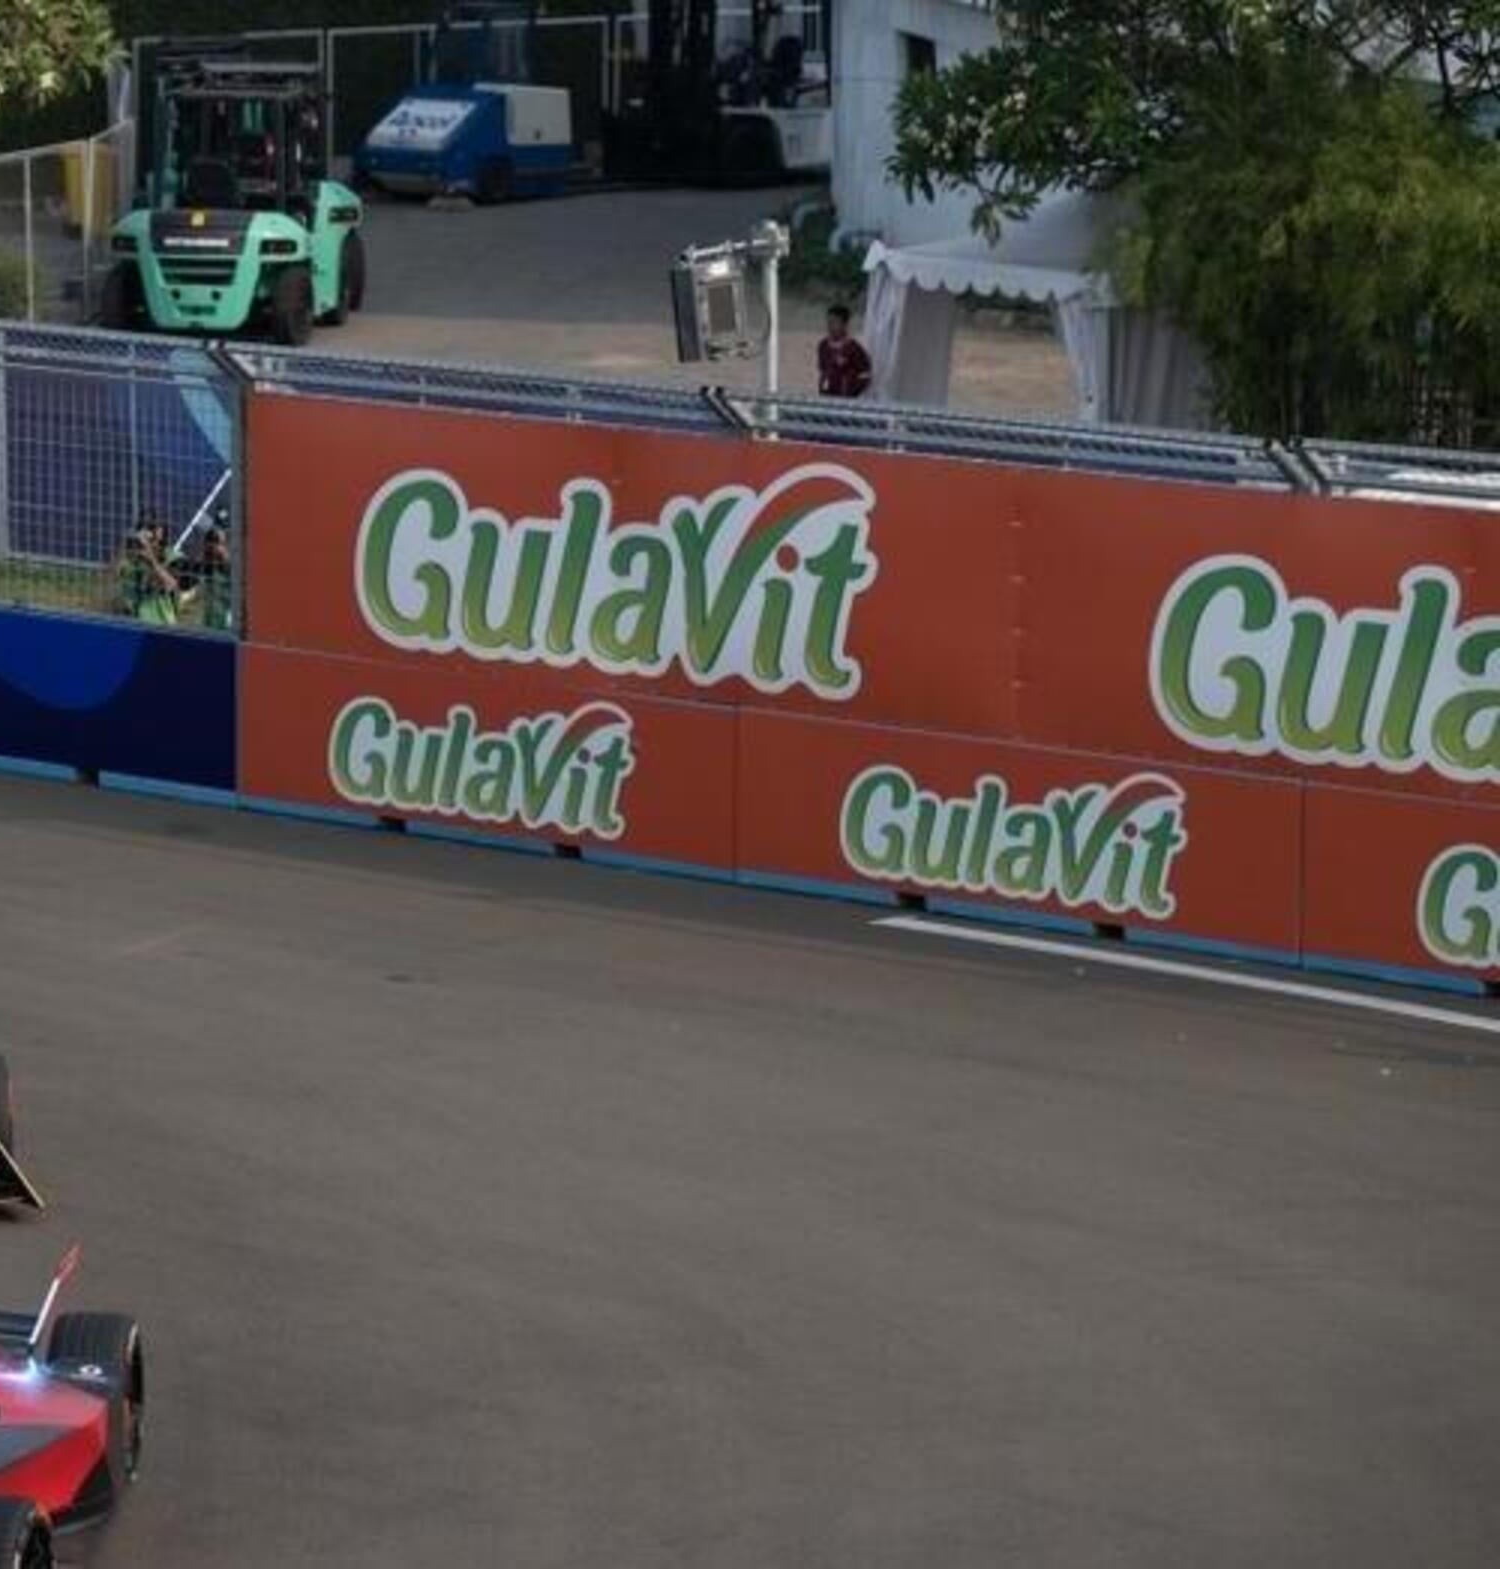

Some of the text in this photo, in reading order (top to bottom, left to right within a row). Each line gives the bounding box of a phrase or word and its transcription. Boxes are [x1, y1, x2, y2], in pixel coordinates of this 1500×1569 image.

[358, 468, 874, 694] GulaVit
[1153, 560, 1500, 780] Gula
[331, 699, 634, 838] GulaVit
[843, 768, 1186, 915] GulaVit
